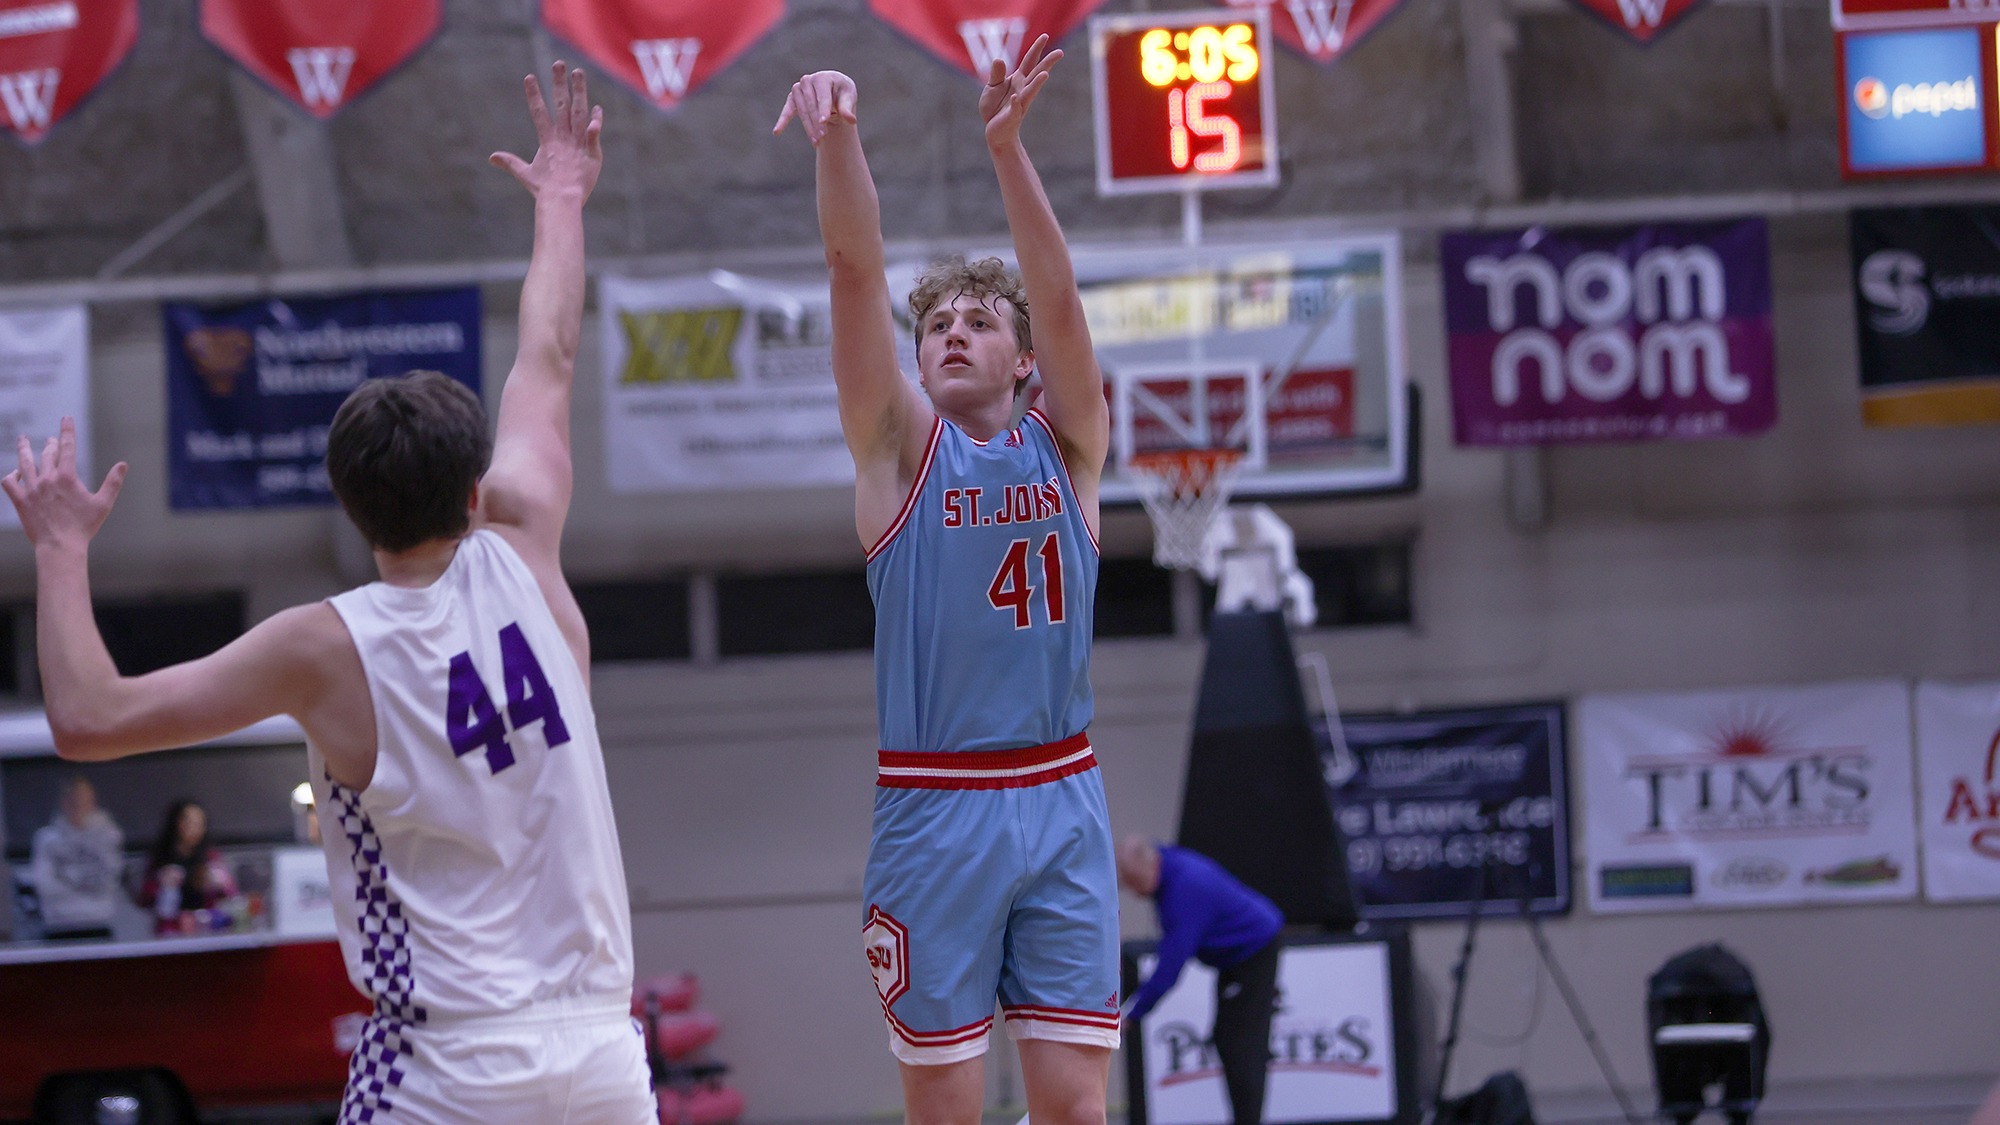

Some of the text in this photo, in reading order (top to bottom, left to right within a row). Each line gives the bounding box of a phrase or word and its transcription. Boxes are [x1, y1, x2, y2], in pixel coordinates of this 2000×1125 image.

[957, 17, 1027, 80] W
[1140, 24, 1258, 86] 6:05
[1286, 0, 1353, 53] W
[0, 68, 60, 128] W
[286, 47, 355, 106] W
[630, 37, 702, 97] W
[1892, 76, 1976, 119] pepsi
[1168, 80, 1240, 172] 15
[1465, 246, 1726, 332] nom
[1492, 318, 1749, 405] nom
[986, 531, 1066, 631] 41
[446, 621, 571, 775] 44
[1623, 753, 1873, 832] TIM'S
